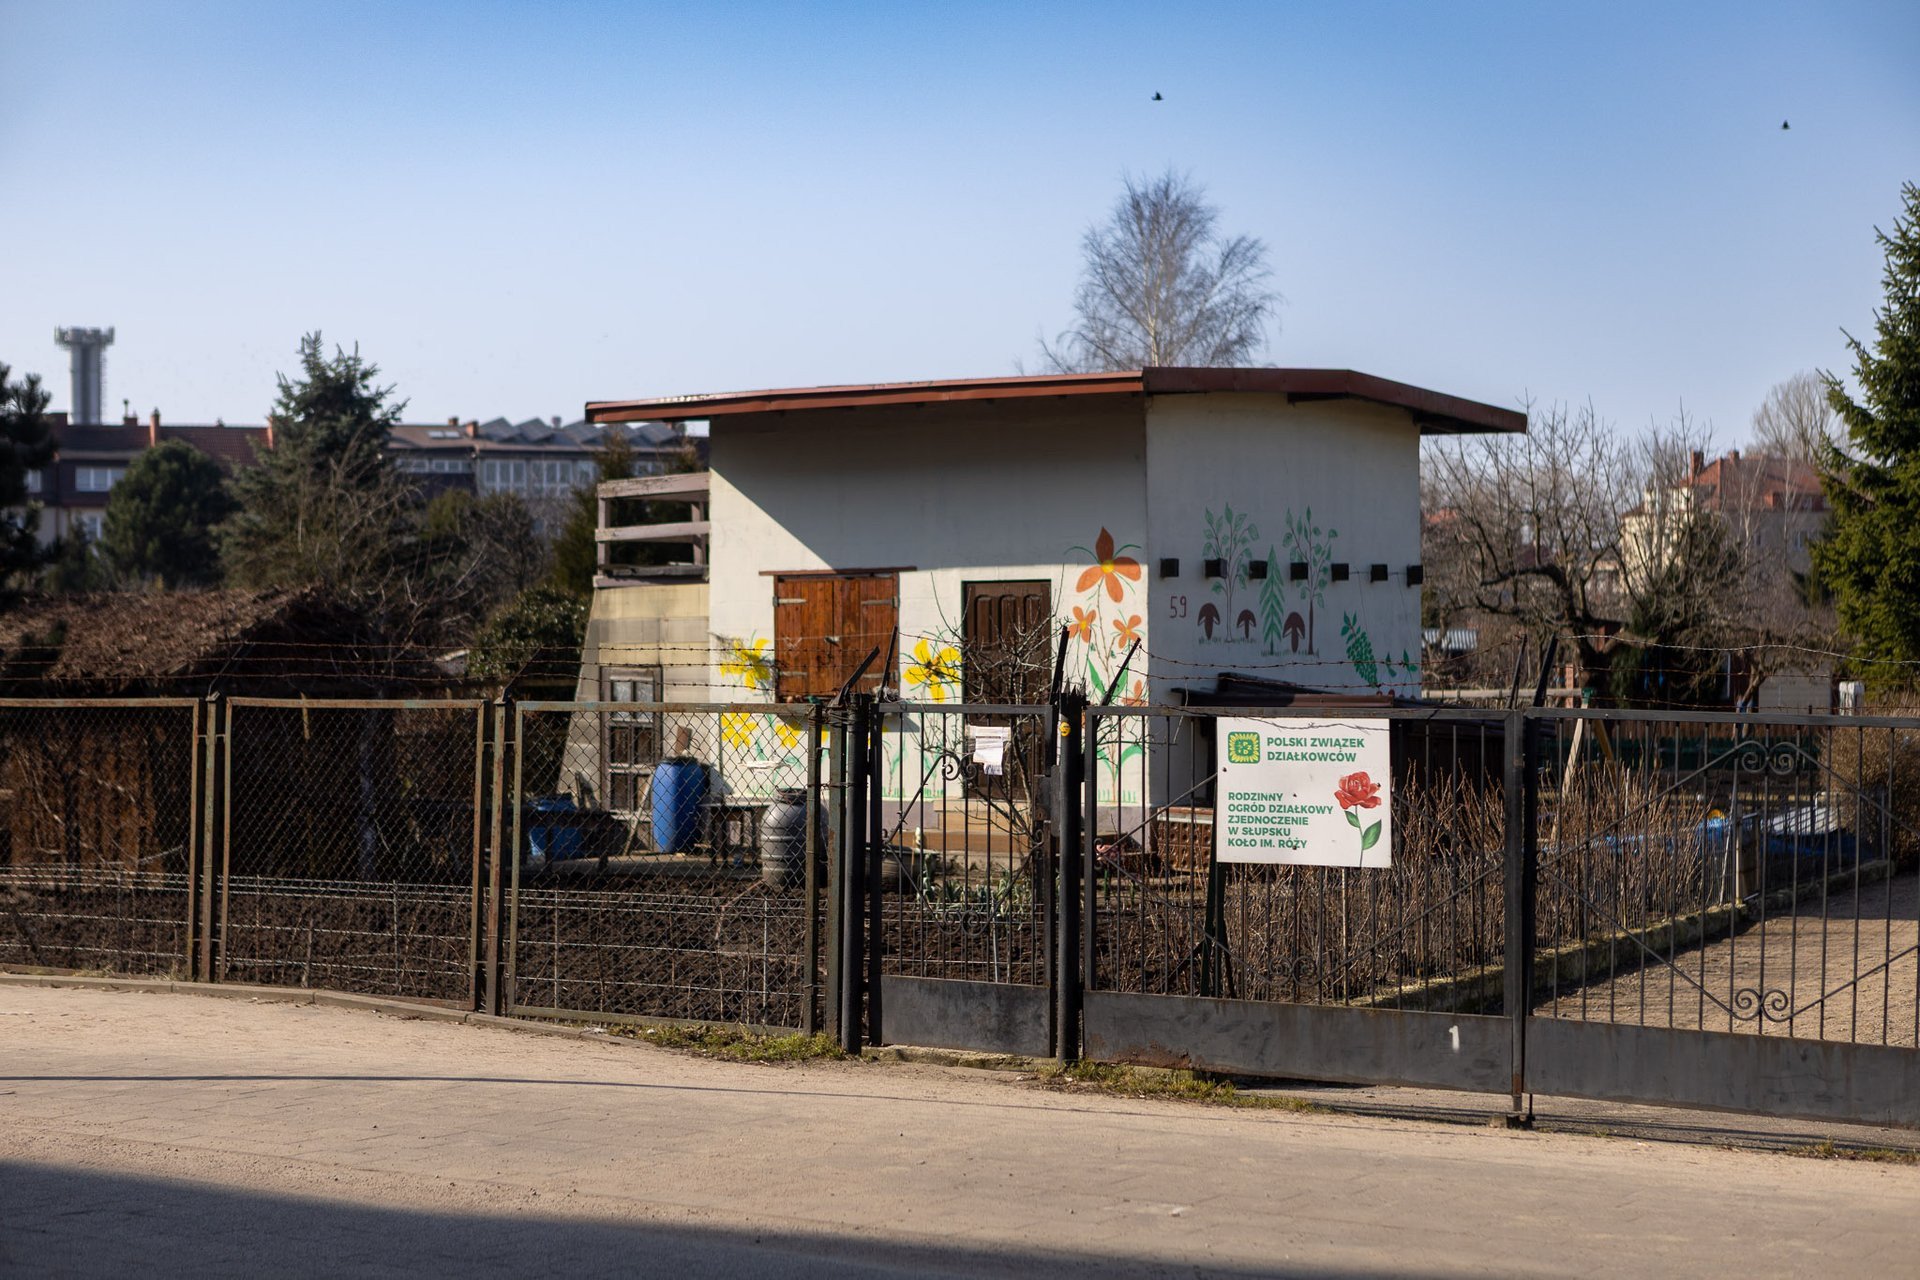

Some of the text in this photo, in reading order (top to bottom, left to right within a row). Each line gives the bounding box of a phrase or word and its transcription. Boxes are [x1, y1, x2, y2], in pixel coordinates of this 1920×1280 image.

[1169, 595, 1187, 618] 59
[1266, 737, 1365, 749] POLSKI ZWIĄZEK
[1267, 751, 1357, 762] DZIAŁKOWCÓW
[1228, 792, 1283, 802] RODZINNY
[1228, 802, 1333, 815] OGRÓD DZIAŁKOWY
[1228, 815, 1309, 826] ZJEDNOCZENIE
[1228, 827, 1291, 836] W SŁUPSKU
[1228, 838, 1307, 849] KOŁO IM. RÓŻY
